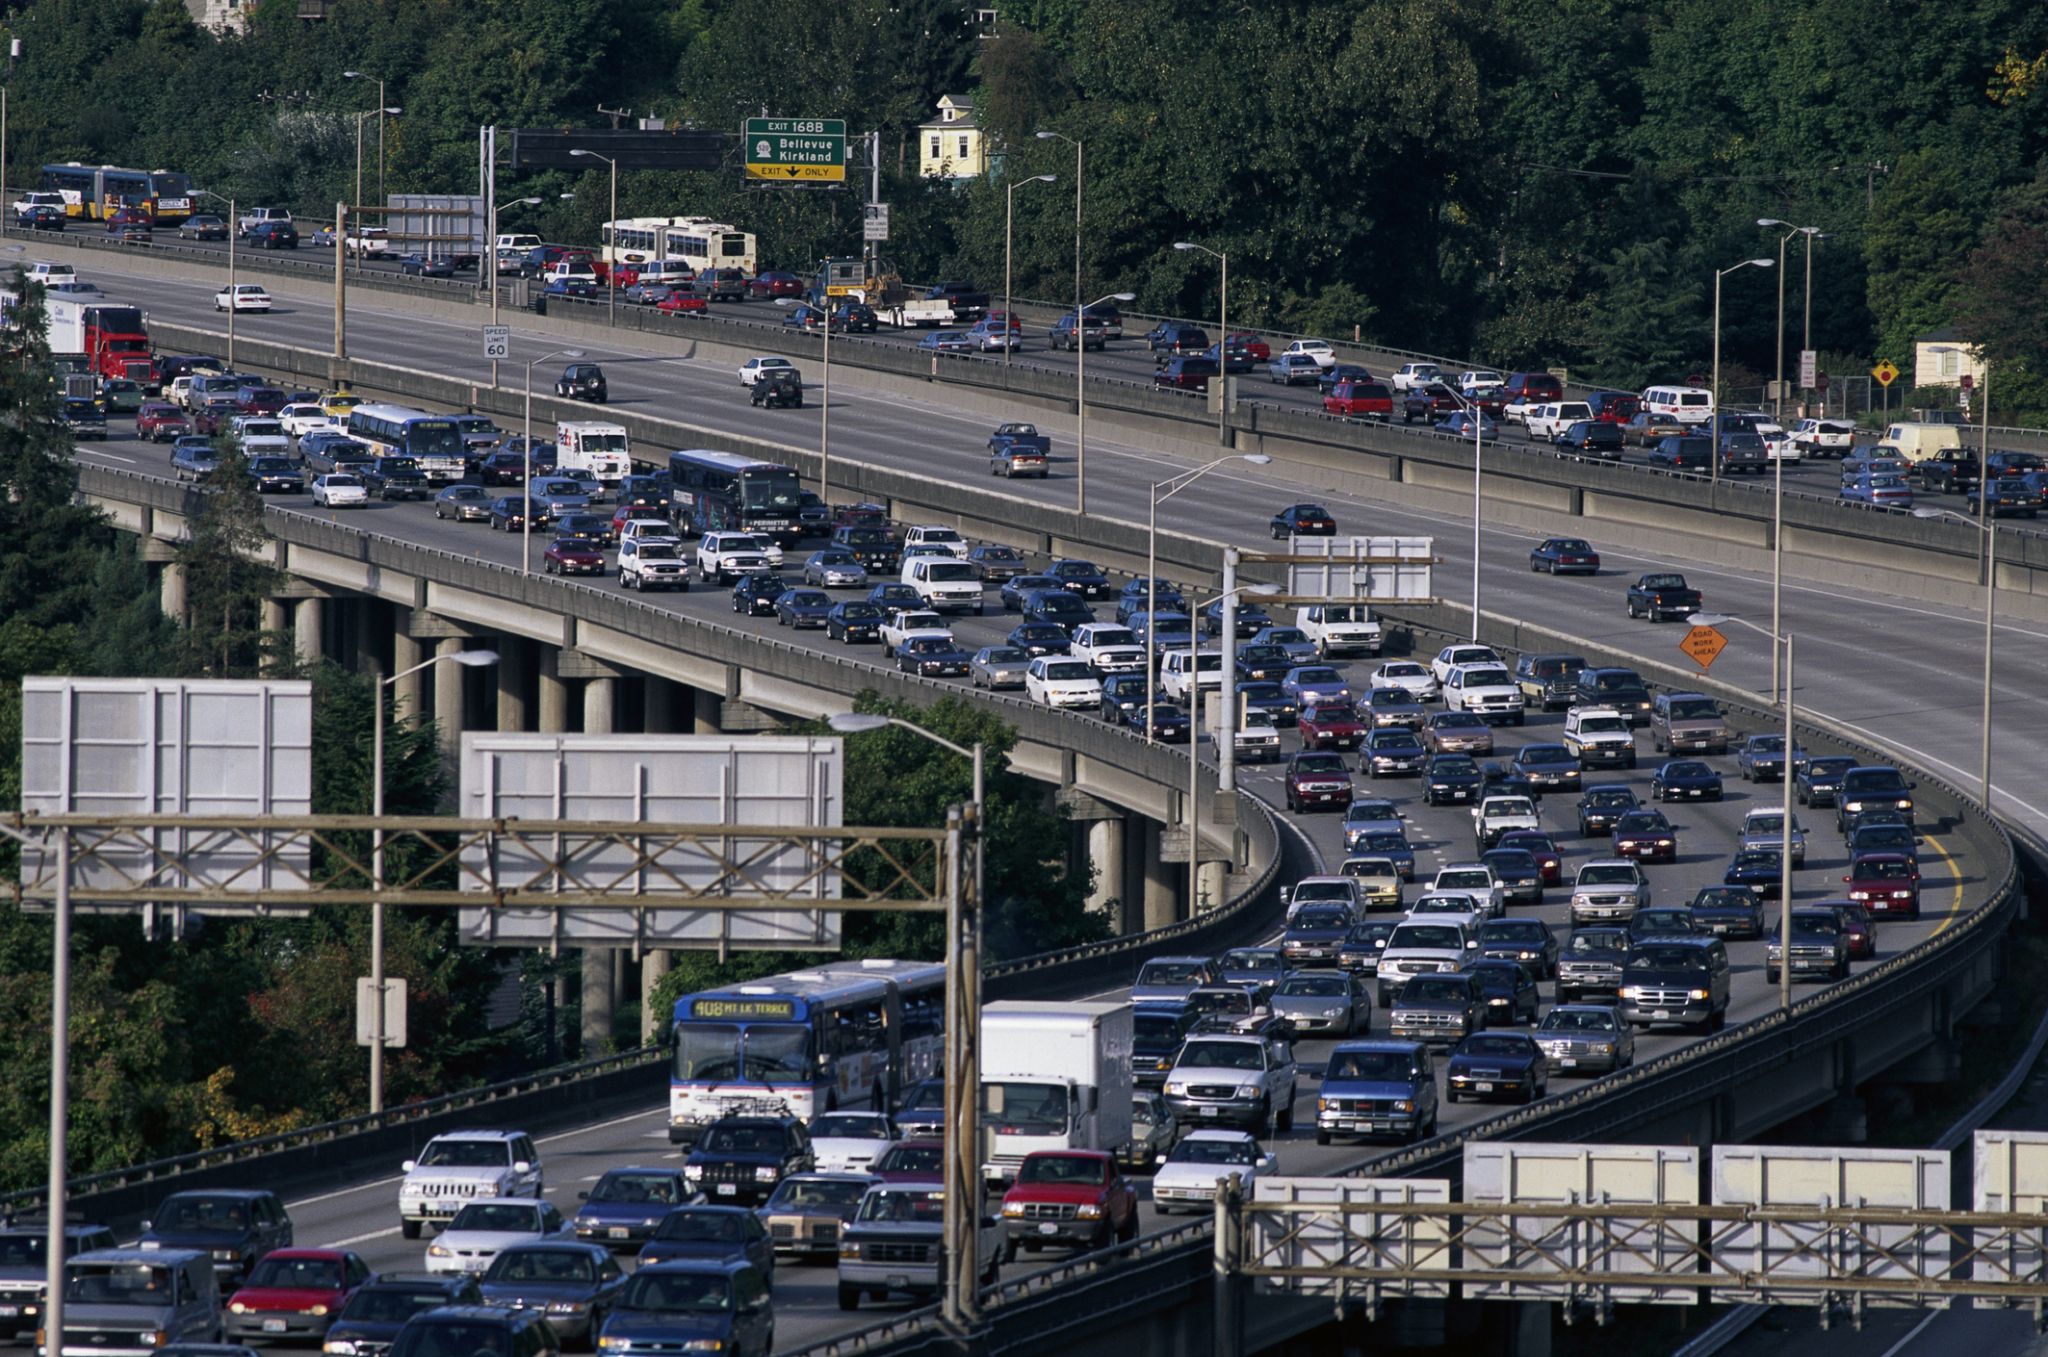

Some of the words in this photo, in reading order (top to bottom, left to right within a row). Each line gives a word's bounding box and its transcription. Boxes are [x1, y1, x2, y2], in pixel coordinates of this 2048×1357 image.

[768, 122, 788, 130] EXIT
[792, 122, 824, 133] 168B
[780, 139, 833, 149] Bellevue
[780, 151, 832, 162] Kirkland
[762, 167, 781, 175] EXIT
[805, 168, 829, 176] ONLY
[488, 345, 505, 355] 60
[1694, 648, 1716, 656] AHEAD
[695, 1001, 723, 1017] 408
